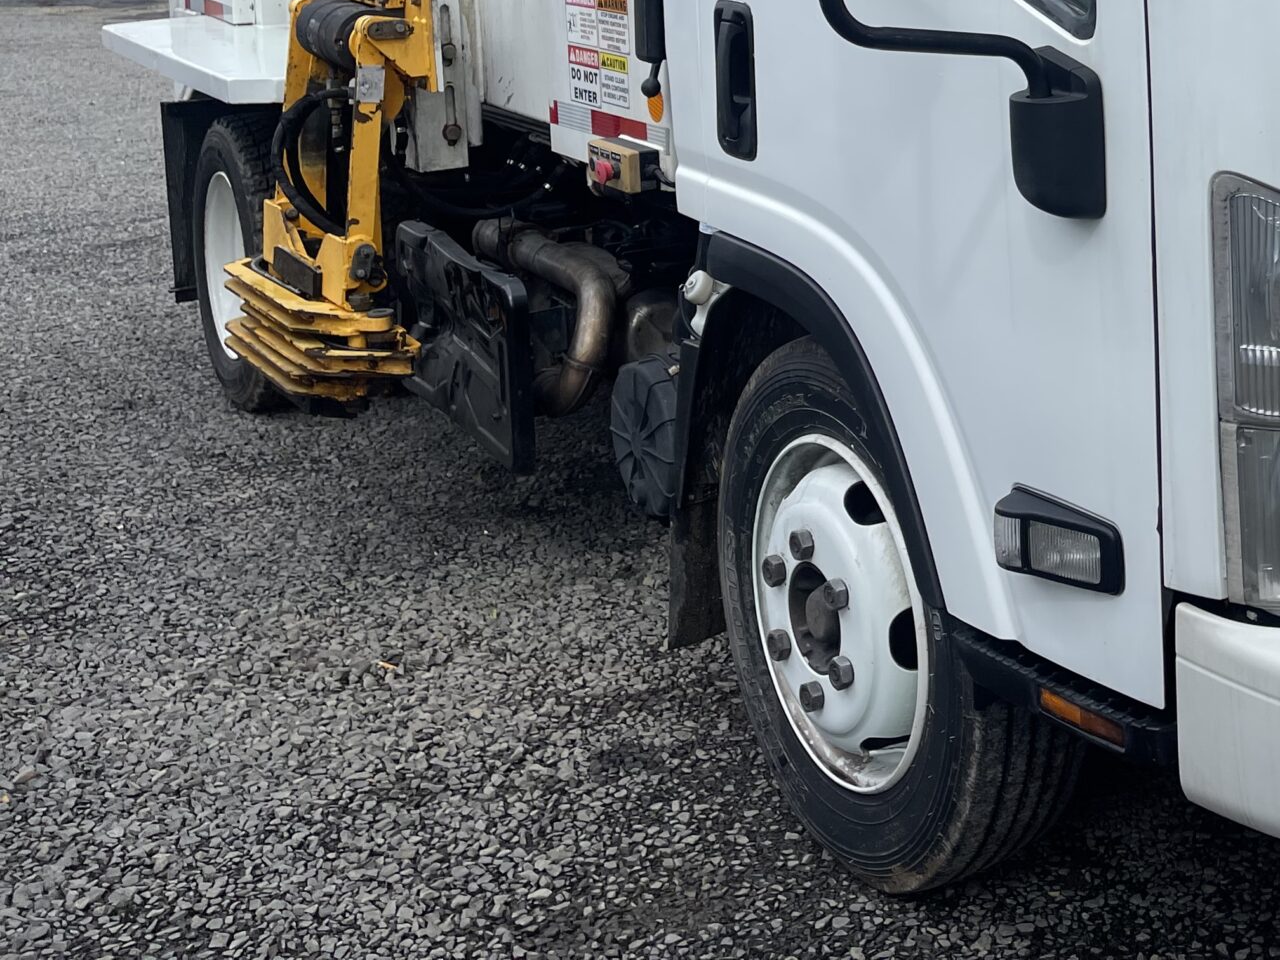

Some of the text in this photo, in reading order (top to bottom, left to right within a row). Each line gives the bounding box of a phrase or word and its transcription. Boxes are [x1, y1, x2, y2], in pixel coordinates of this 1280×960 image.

[575, 48, 599, 67] DANGER
[606, 57, 626, 71] CAUTION
[571, 67, 598, 85] DO NOT
[574, 86, 598, 104] ENTER
